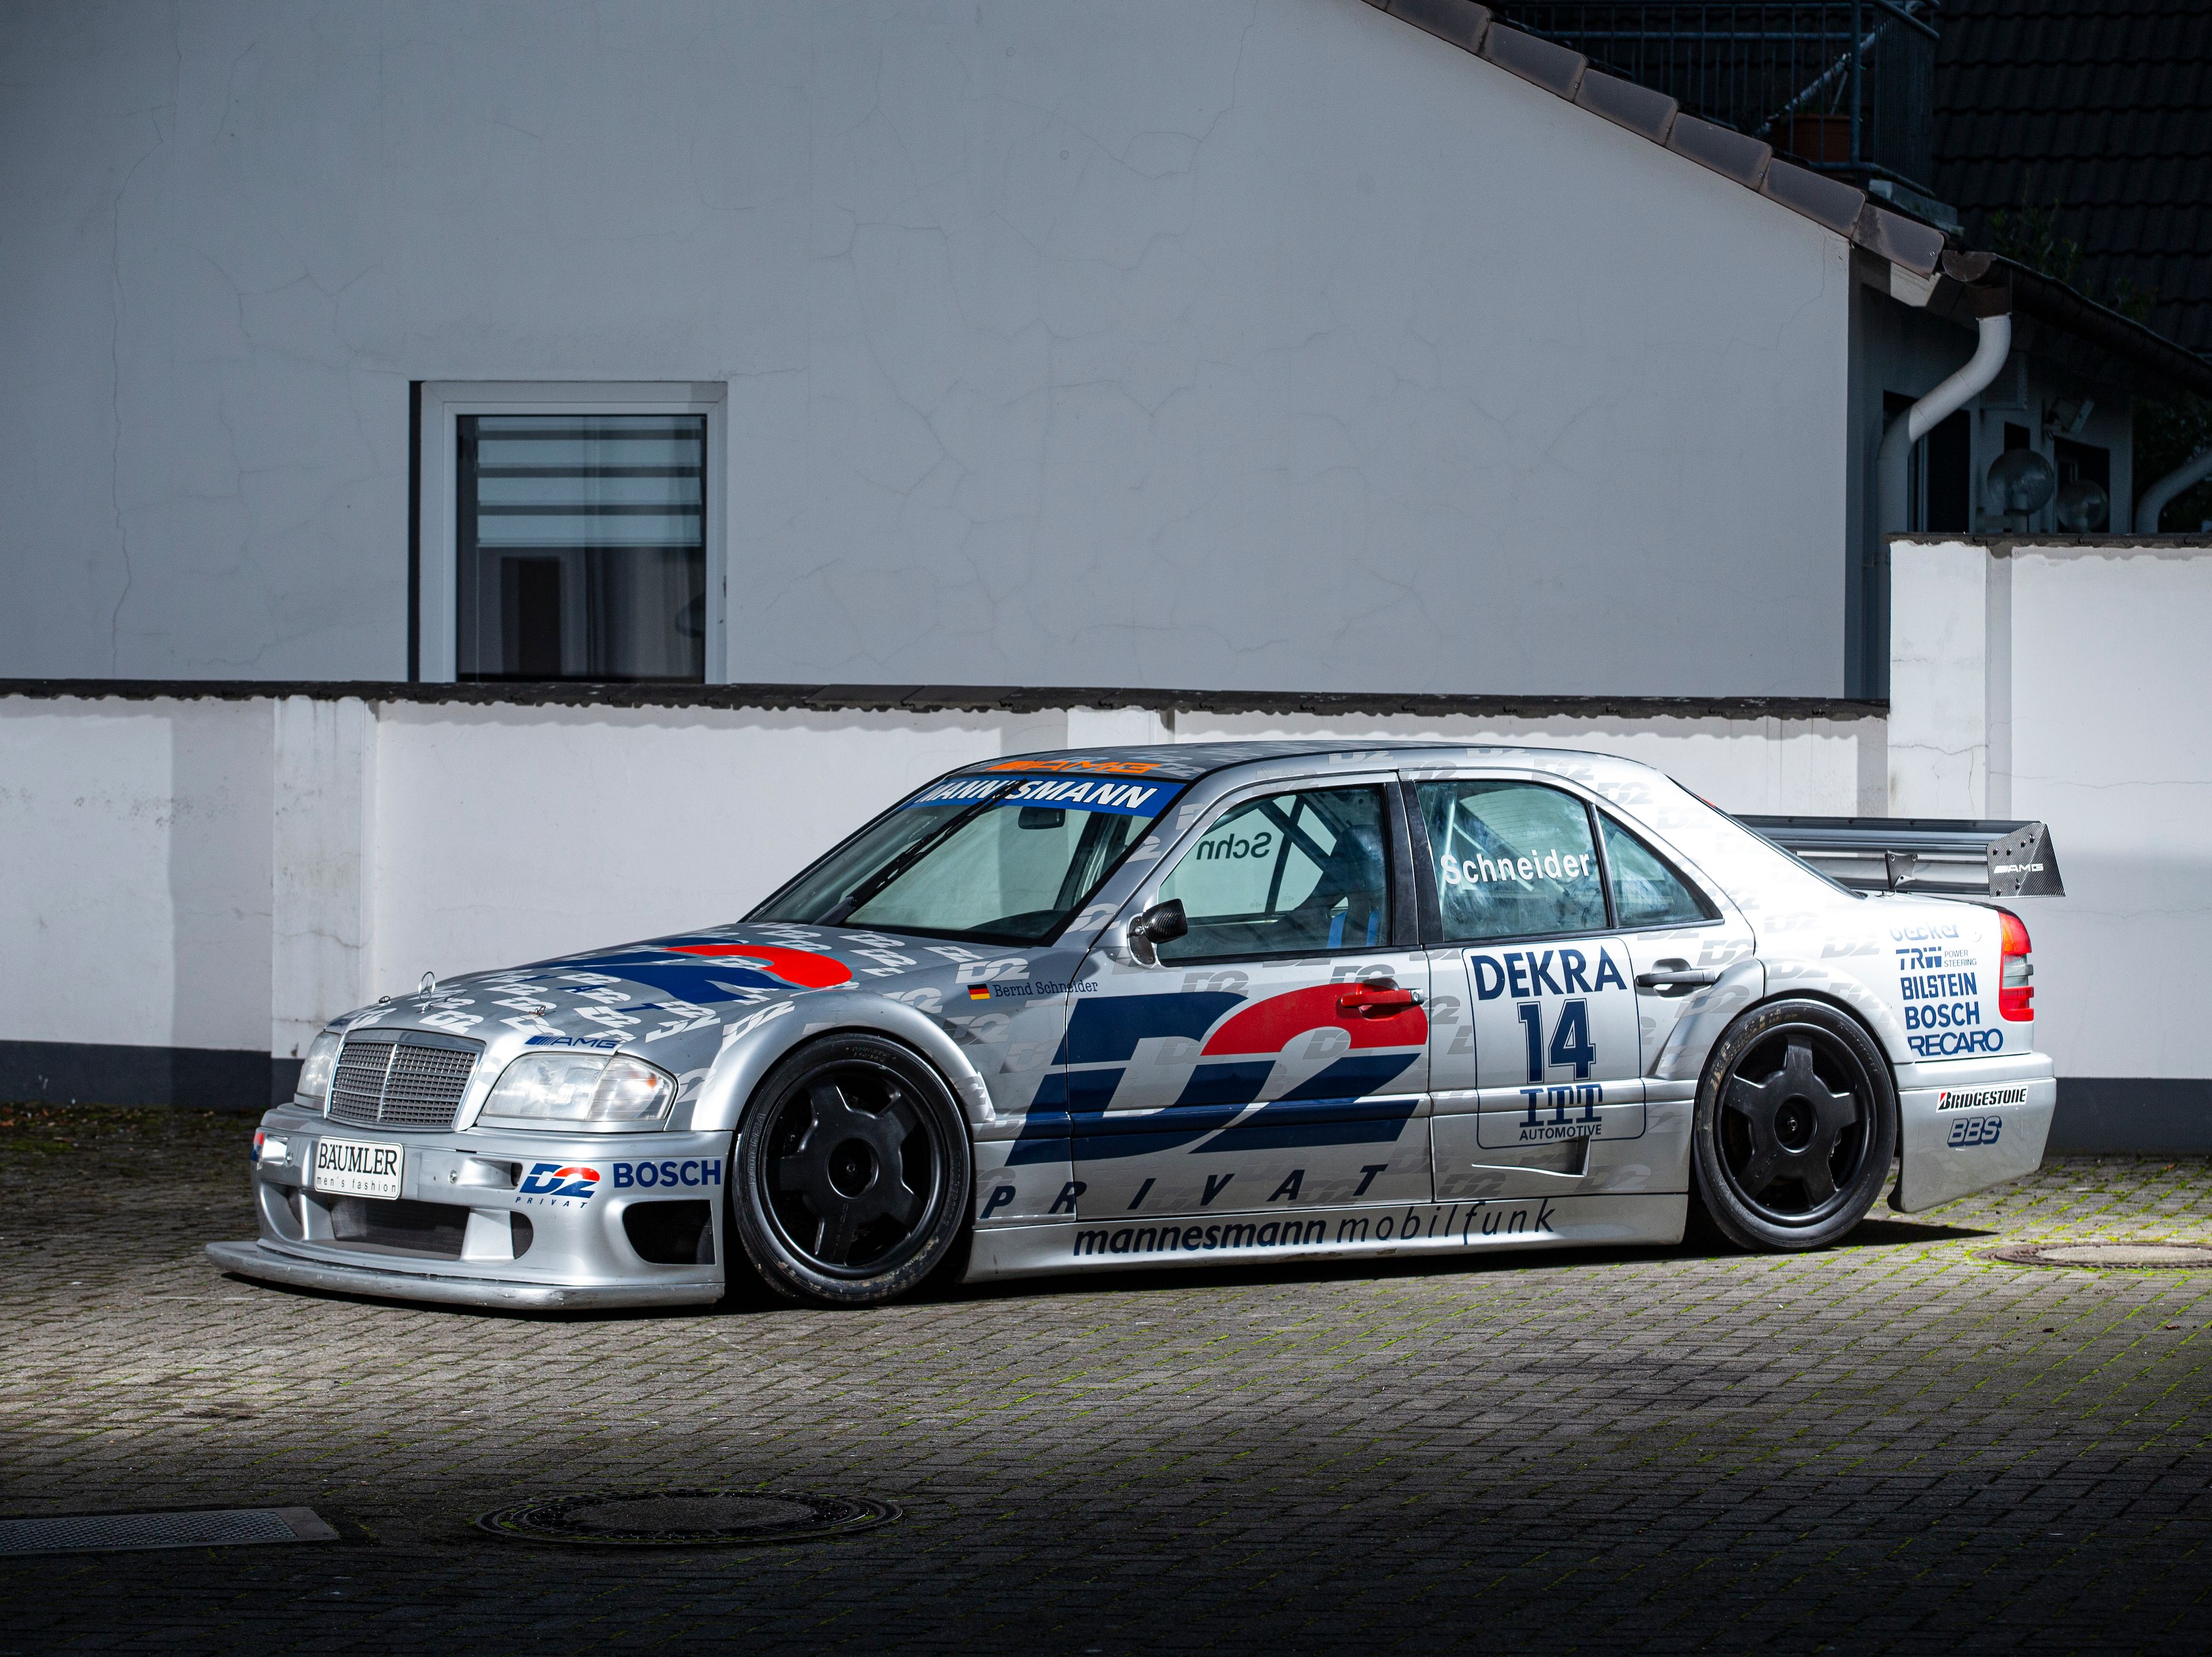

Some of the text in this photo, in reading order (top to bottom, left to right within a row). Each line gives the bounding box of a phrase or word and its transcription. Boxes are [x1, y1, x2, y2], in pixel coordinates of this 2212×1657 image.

[1034, 760, 1160, 774] AMG
[1440, 849, 1590, 885] Schneider
[2006, 862, 2044, 873] AMG
[1896, 946, 1942, 970] TRW
[1944, 949, 1969, 958] POWER
[1944, 958, 1977, 968] STEERING
[955, 957, 1031, 984] D2
[1181, 971, 1249, 993] D2
[1470, 945, 1627, 1001] DEKRA
[992, 980, 1098, 997] Bernd Schneider
[1900, 972, 1977, 1000] BILSTEIN
[1905, 1002, 1980, 1030] BOSCH
[551, 1037, 622, 1049] AMG
[1518, 998, 1596, 1084] 14
[1908, 1028, 2003, 1056] RECARO
[1004, 982, 1428, 1167] D2
[1519, 1084, 1603, 1128] ITT
[1938, 1088, 2027, 1110] BRIDGESTONE
[1519, 1124, 1602, 1141] AUTOMOTIVE
[1947, 1116, 2002, 1147] BBS
[318, 1143, 397, 1176] BÄUMLER
[352, 1181, 396, 1193] fashion
[519, 1163, 600, 1198] D2
[613, 1160, 721, 1188] BOSCH
[515, 1196, 587, 1208] PRIVAT
[980, 1164, 1388, 1219] PRIVAT
[1073, 1198, 1556, 1257] mannesmann mobilfunk
